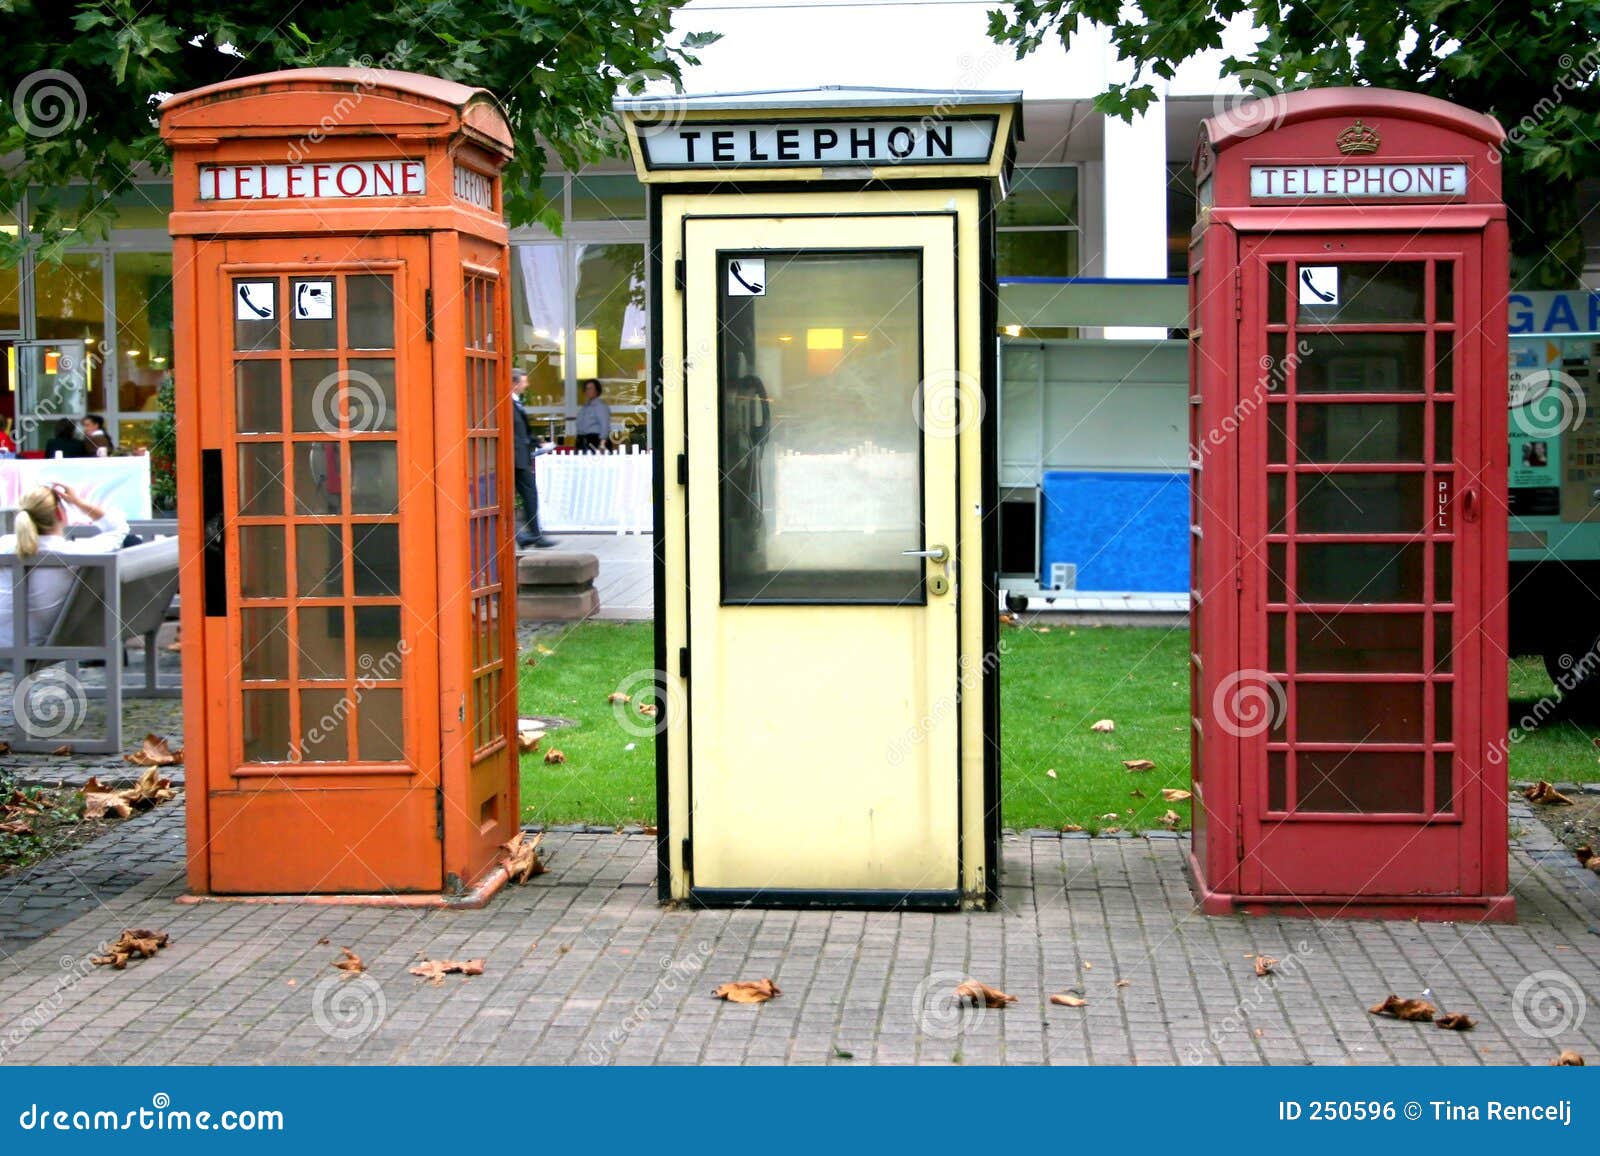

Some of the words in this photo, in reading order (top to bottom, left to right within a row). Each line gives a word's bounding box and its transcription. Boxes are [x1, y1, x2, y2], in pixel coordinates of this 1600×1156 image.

[680, 126, 953, 162] TELEPHON
[205, 162, 422, 199] TELEFONE
[454, 165, 492, 209] ELEFONE
[1260, 167, 1455, 194] TELEPHONE
[1439, 481, 1447, 527] PULL
